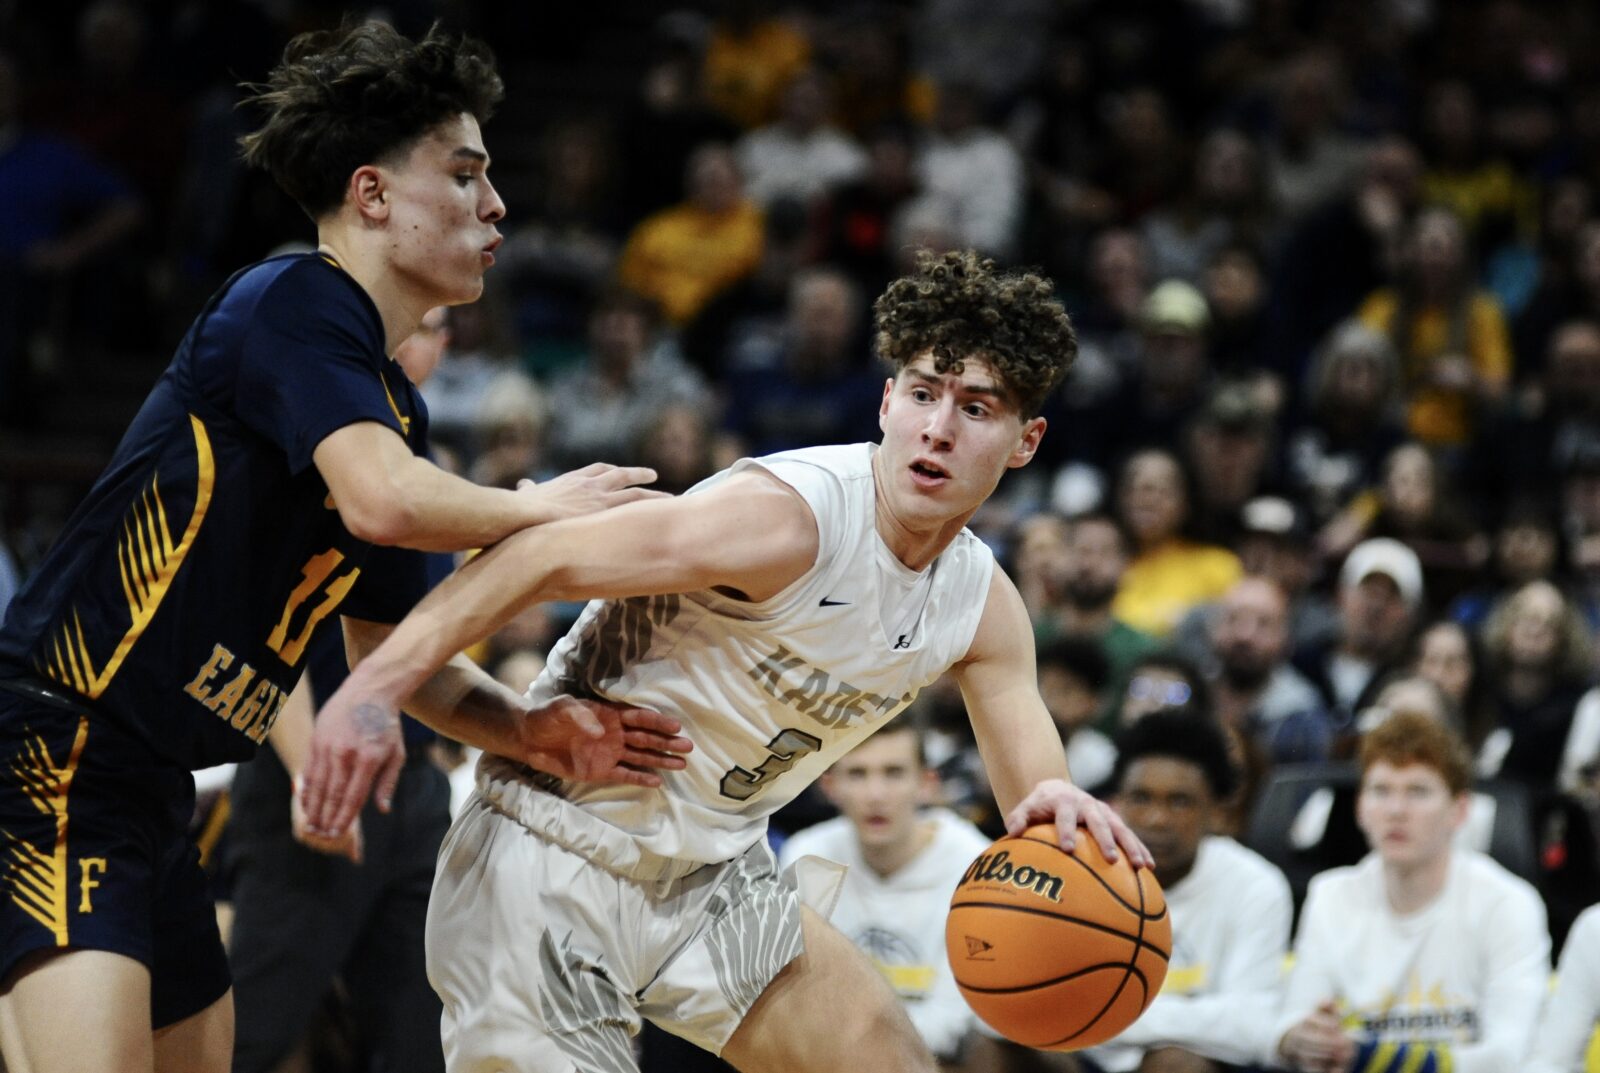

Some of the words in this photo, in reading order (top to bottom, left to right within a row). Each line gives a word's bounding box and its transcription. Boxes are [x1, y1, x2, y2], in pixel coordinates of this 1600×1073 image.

[265, 547, 361, 668] 11
[719, 727, 823, 802] 3
[78, 857, 107, 914] F
